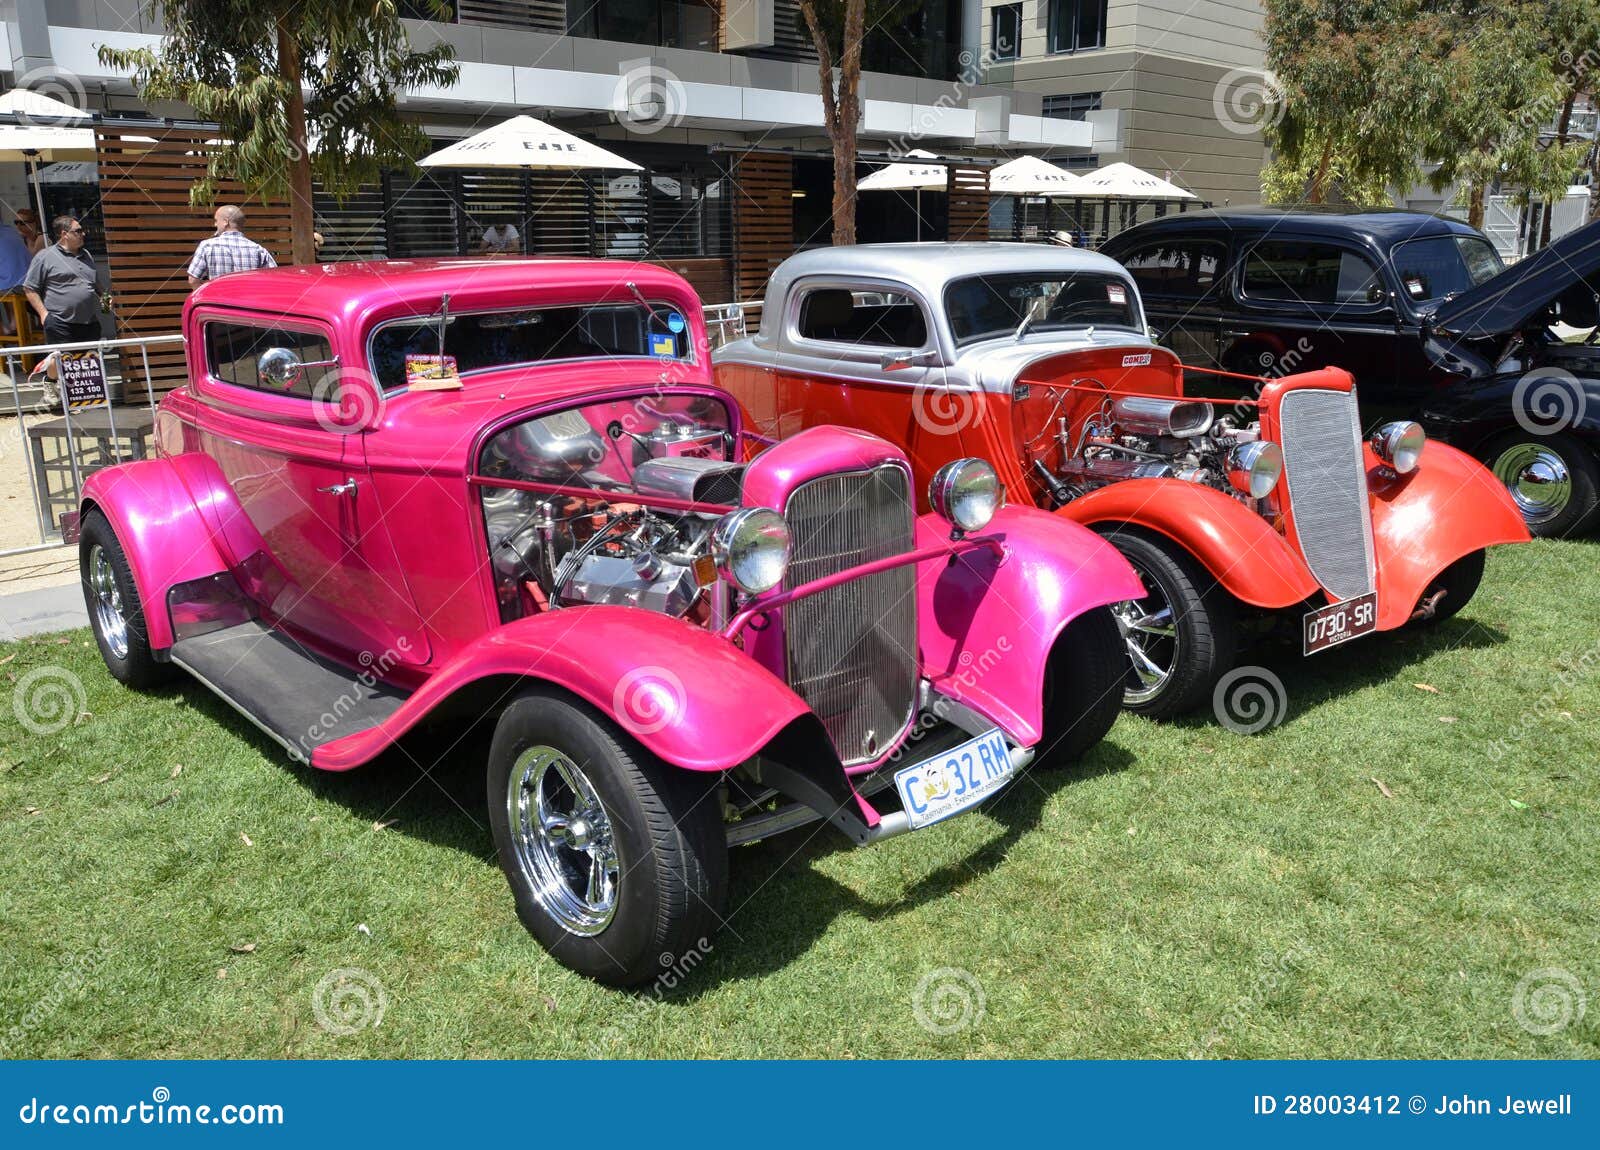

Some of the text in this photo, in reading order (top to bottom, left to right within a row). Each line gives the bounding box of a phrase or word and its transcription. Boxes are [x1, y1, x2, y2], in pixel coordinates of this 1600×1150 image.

[63, 360, 99, 371] RSEA
[1328, 630, 1352, 643] VICTORIA
[905, 776, 928, 814] C
[921, 803, 952, 821] Tasmania
